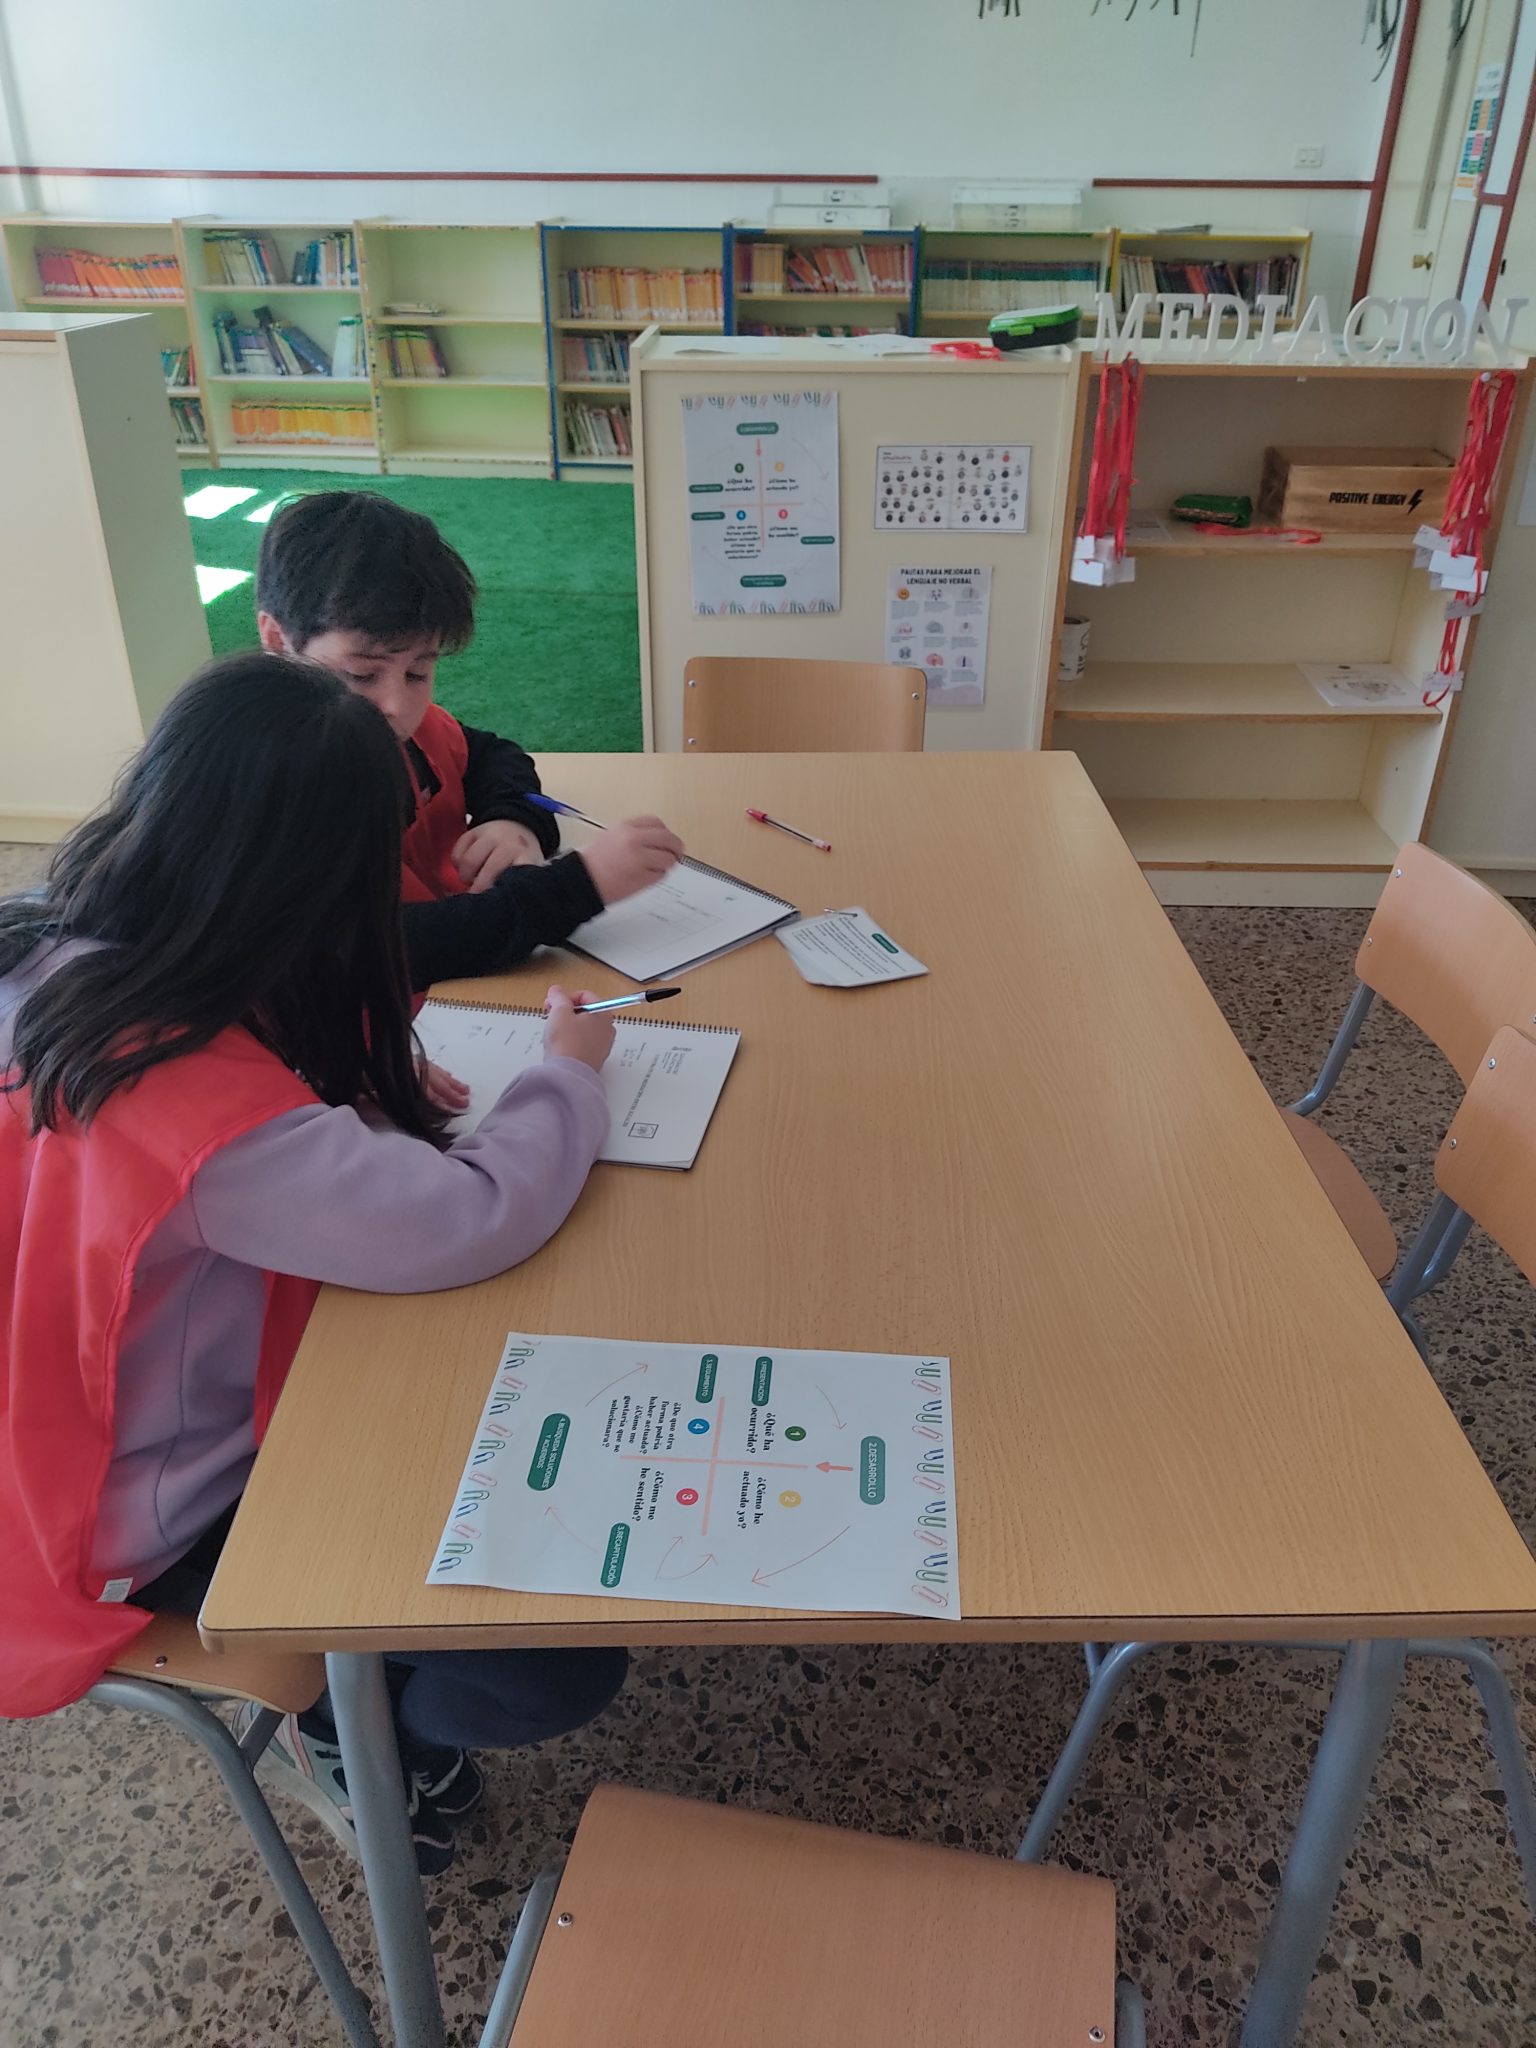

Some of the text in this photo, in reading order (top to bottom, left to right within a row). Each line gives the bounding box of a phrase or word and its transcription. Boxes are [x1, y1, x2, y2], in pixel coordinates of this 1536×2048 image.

[1093, 292, 1530, 365] MEDIACION
[1329, 492, 1407, 506] POSITIVE ENERGY
[658, 1401, 670, 1424] forma
[602, 1399, 618, 1448] solucionara?
[640, 1396, 658, 1454] haber actuado?
[746, 1407, 758, 1454] ocurrido?
[615, 1428, 624, 1442] que
[629, 1432, 636, 1444] me
[666, 1433, 675, 1450] otra
[763, 1439, 774, 1451] ha
[632, 1467, 651, 1522] he sentido?
[736, 1471, 751, 1529] actuado yo?
[647, 1505, 656, 1521] me
[753, 1511, 764, 1525] he
